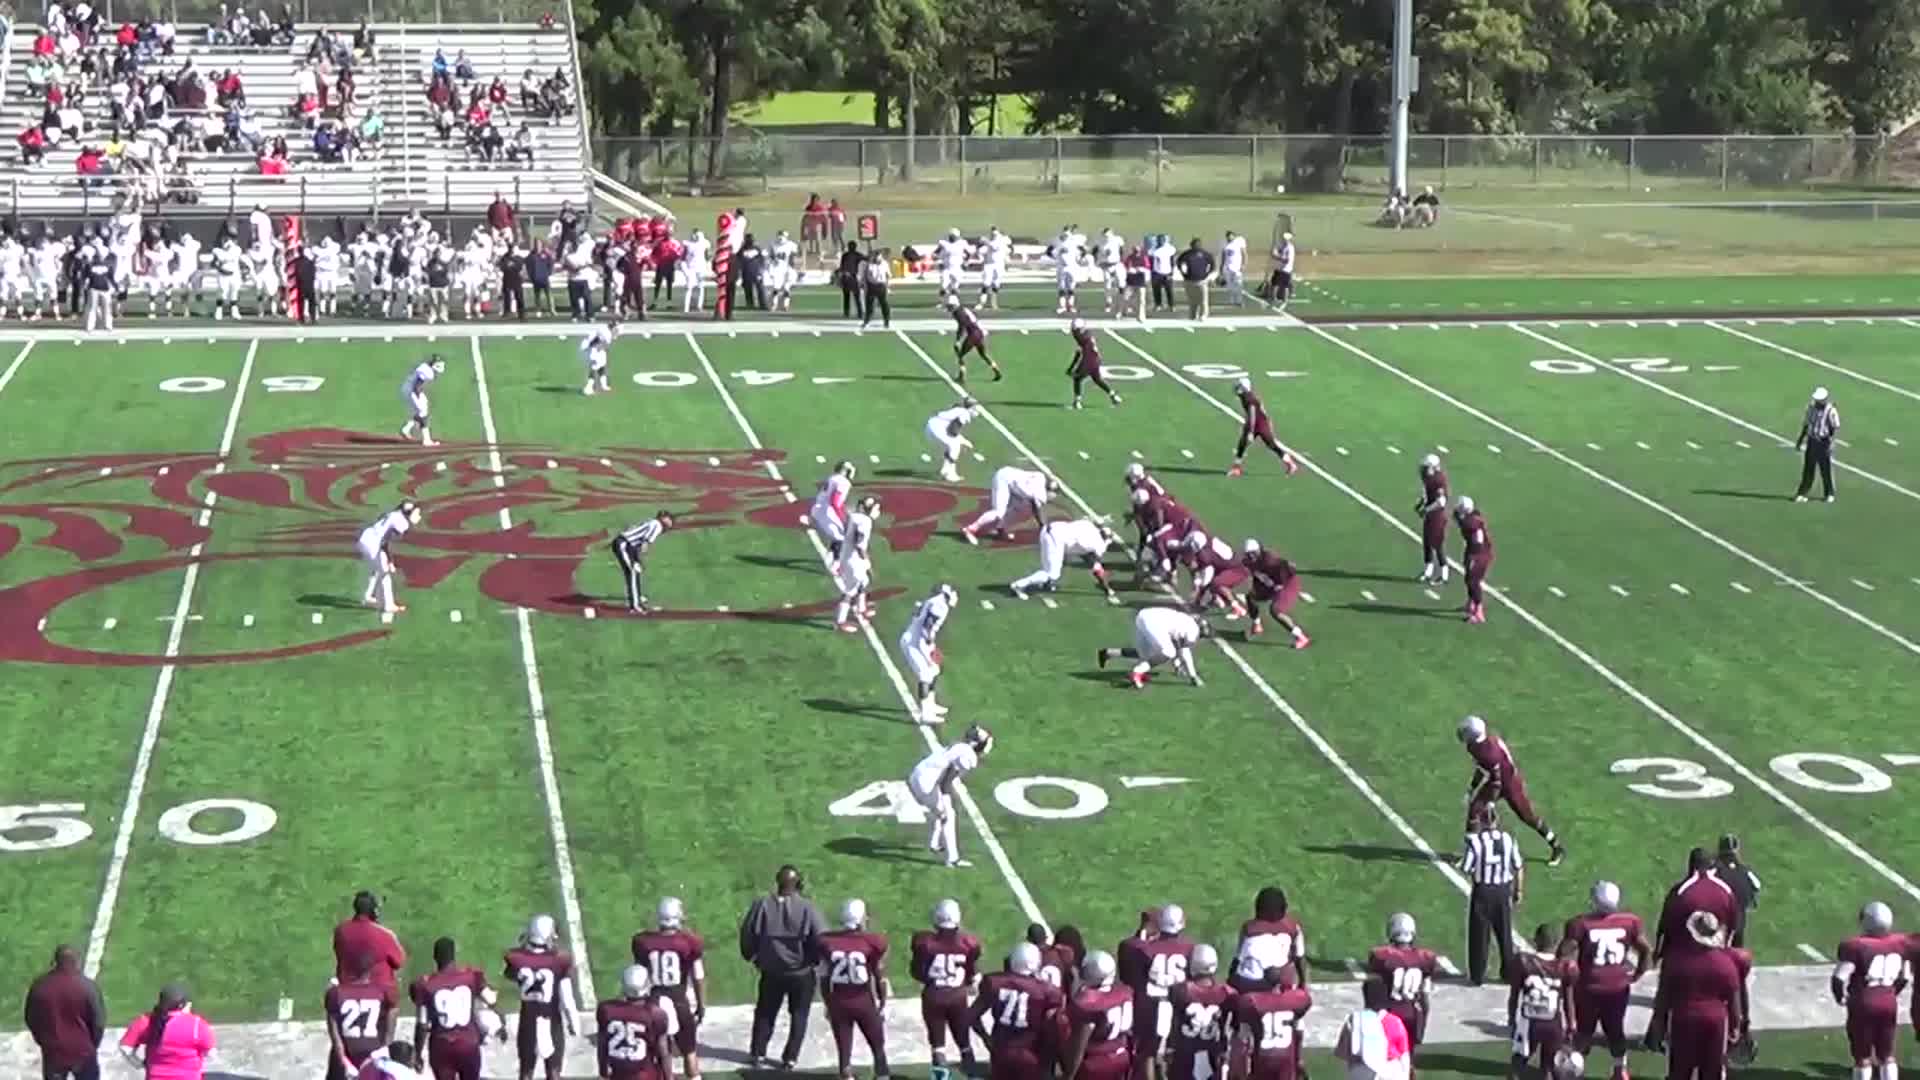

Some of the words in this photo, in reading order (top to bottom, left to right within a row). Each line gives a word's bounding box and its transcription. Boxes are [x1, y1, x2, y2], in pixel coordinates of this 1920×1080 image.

[1589, 928, 1627, 966] 75
[518, 966, 555, 1003] 23
[648, 950, 682, 987] 18
[830, 951, 870, 985] 26
[927, 953, 967, 988] 45
[1150, 953, 1188, 987] 46
[1392, 966, 1423, 1001] 10
[339, 998, 381, 1039] 27
[998, 987, 1029, 1028] 71
[606, 1019, 648, 1061] 25
[1260, 1010, 1295, 1050] 15
